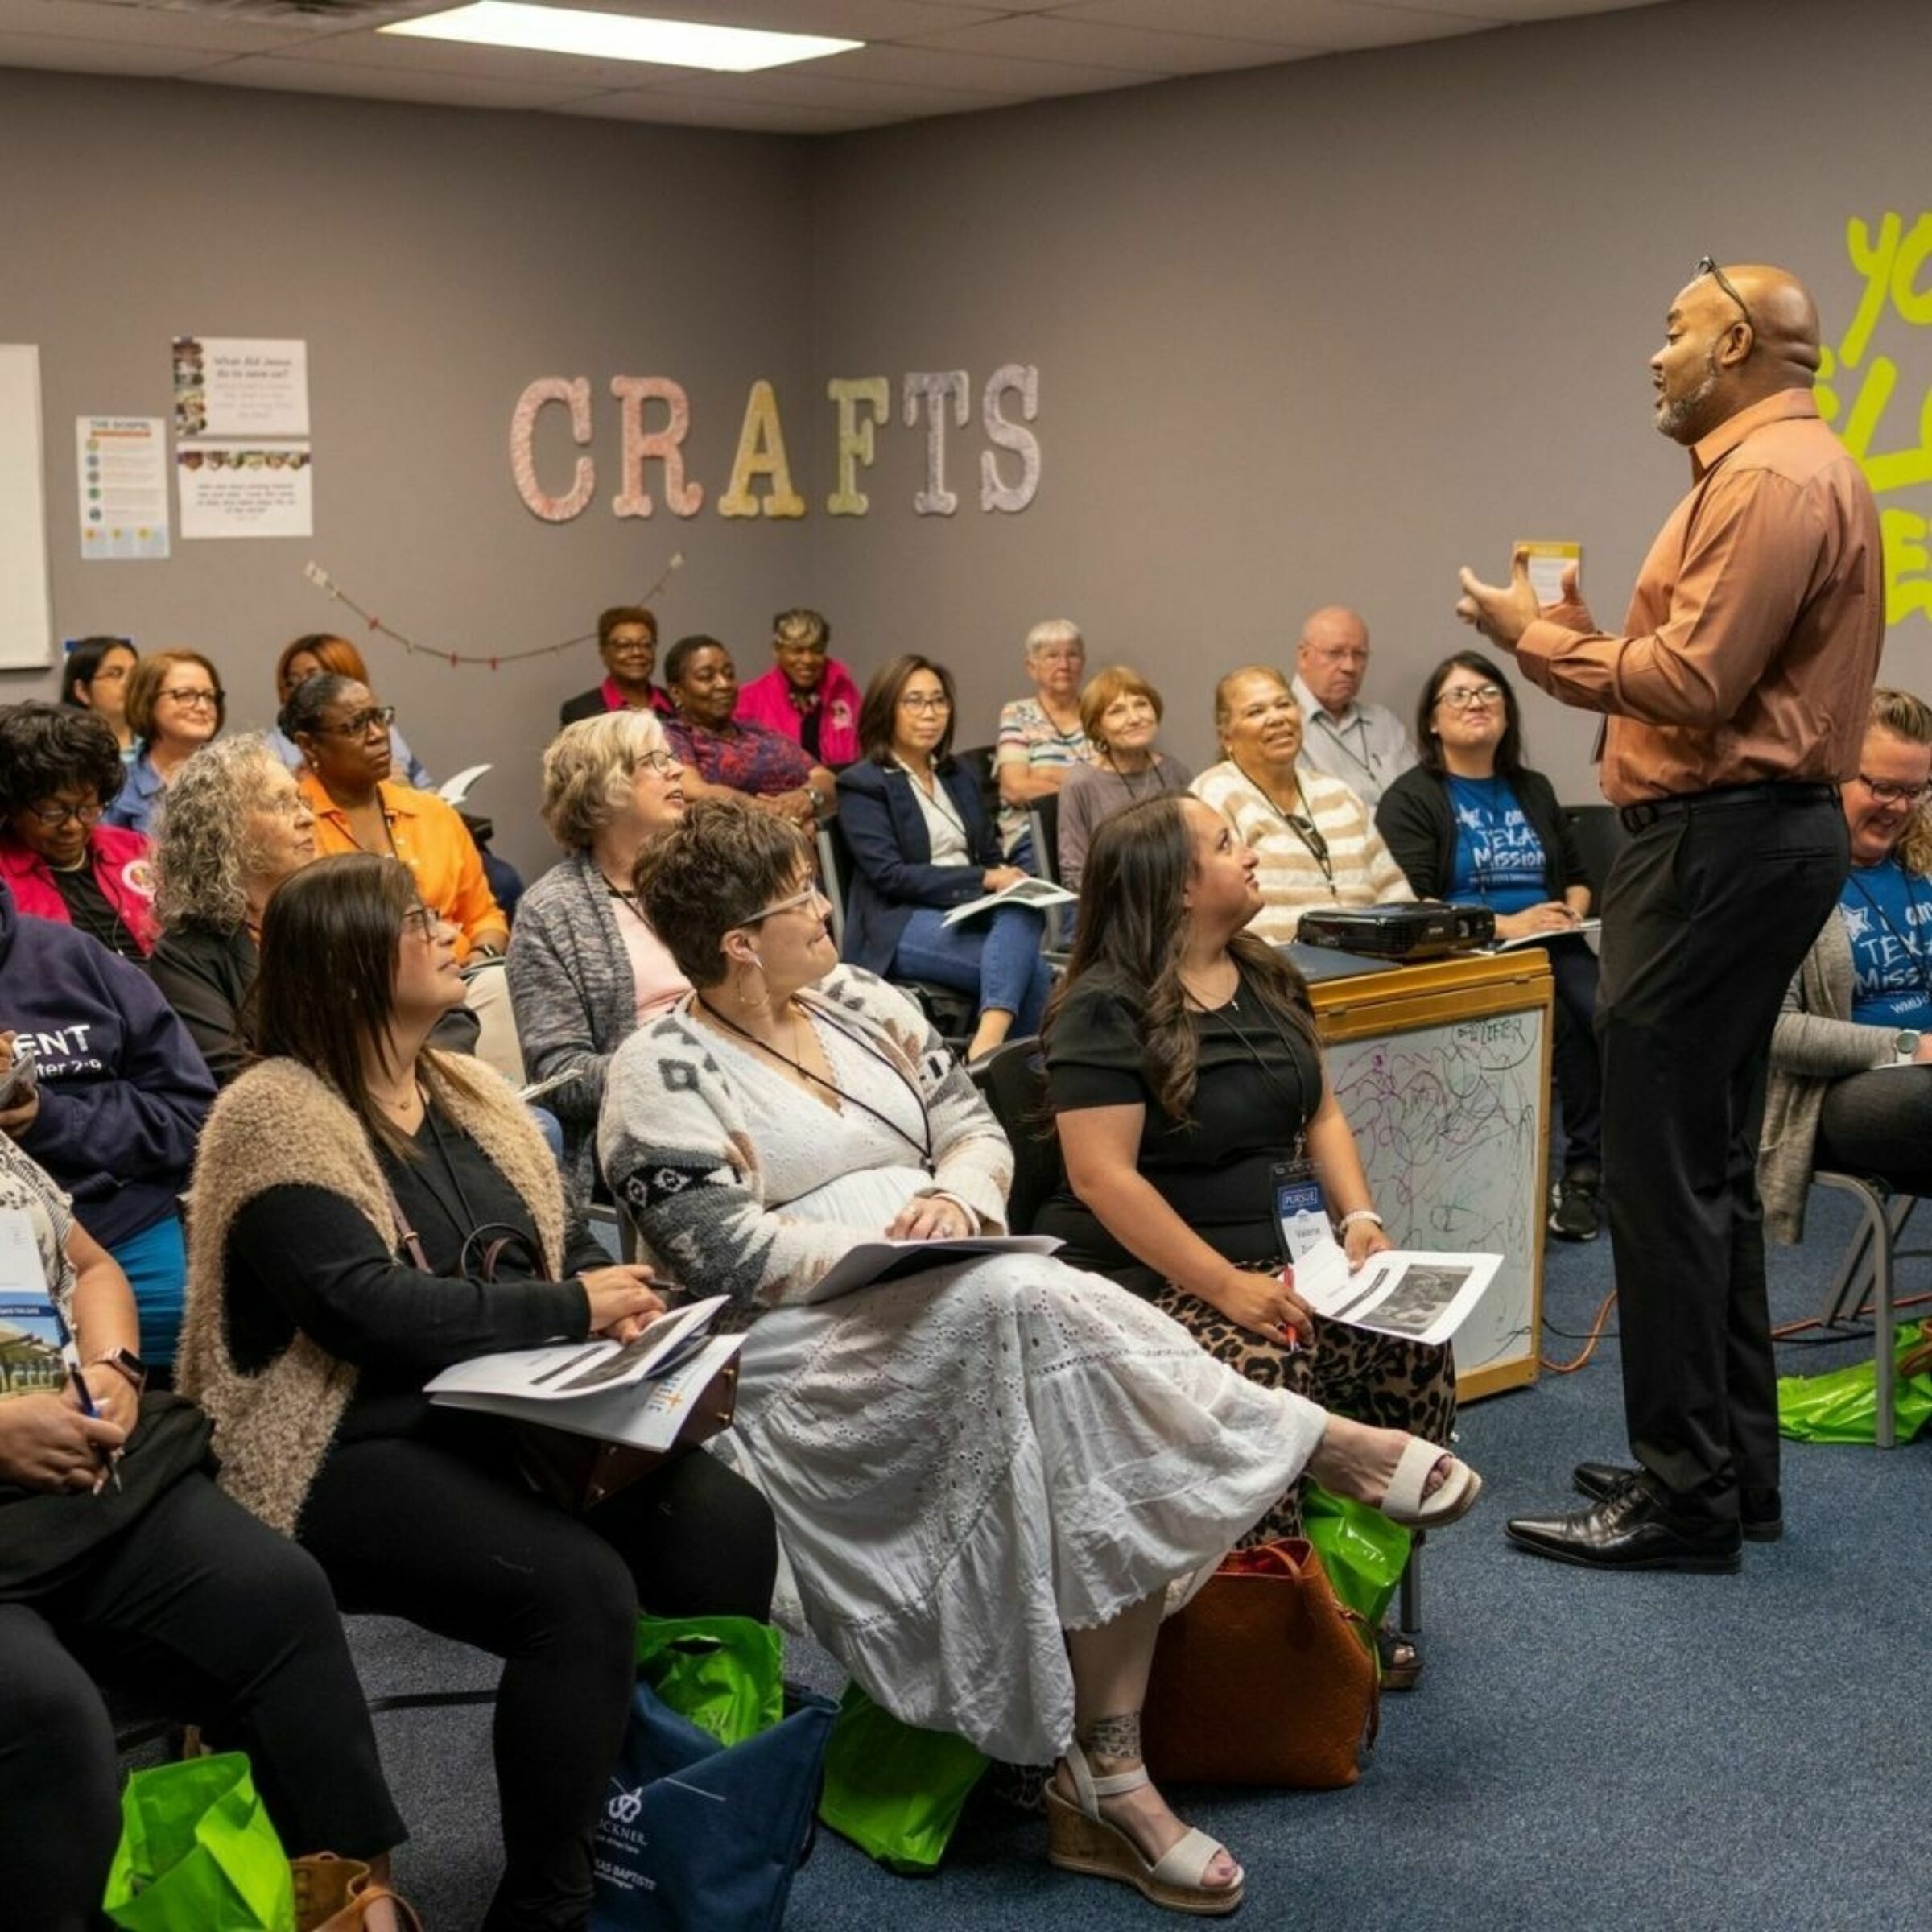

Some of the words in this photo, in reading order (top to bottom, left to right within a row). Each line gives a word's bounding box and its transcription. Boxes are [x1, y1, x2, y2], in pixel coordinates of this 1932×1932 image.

[510, 362, 1042, 523] CRAFTS
[12, 1023, 90, 1059] ENT
[36, 1062, 66, 1077] ter
